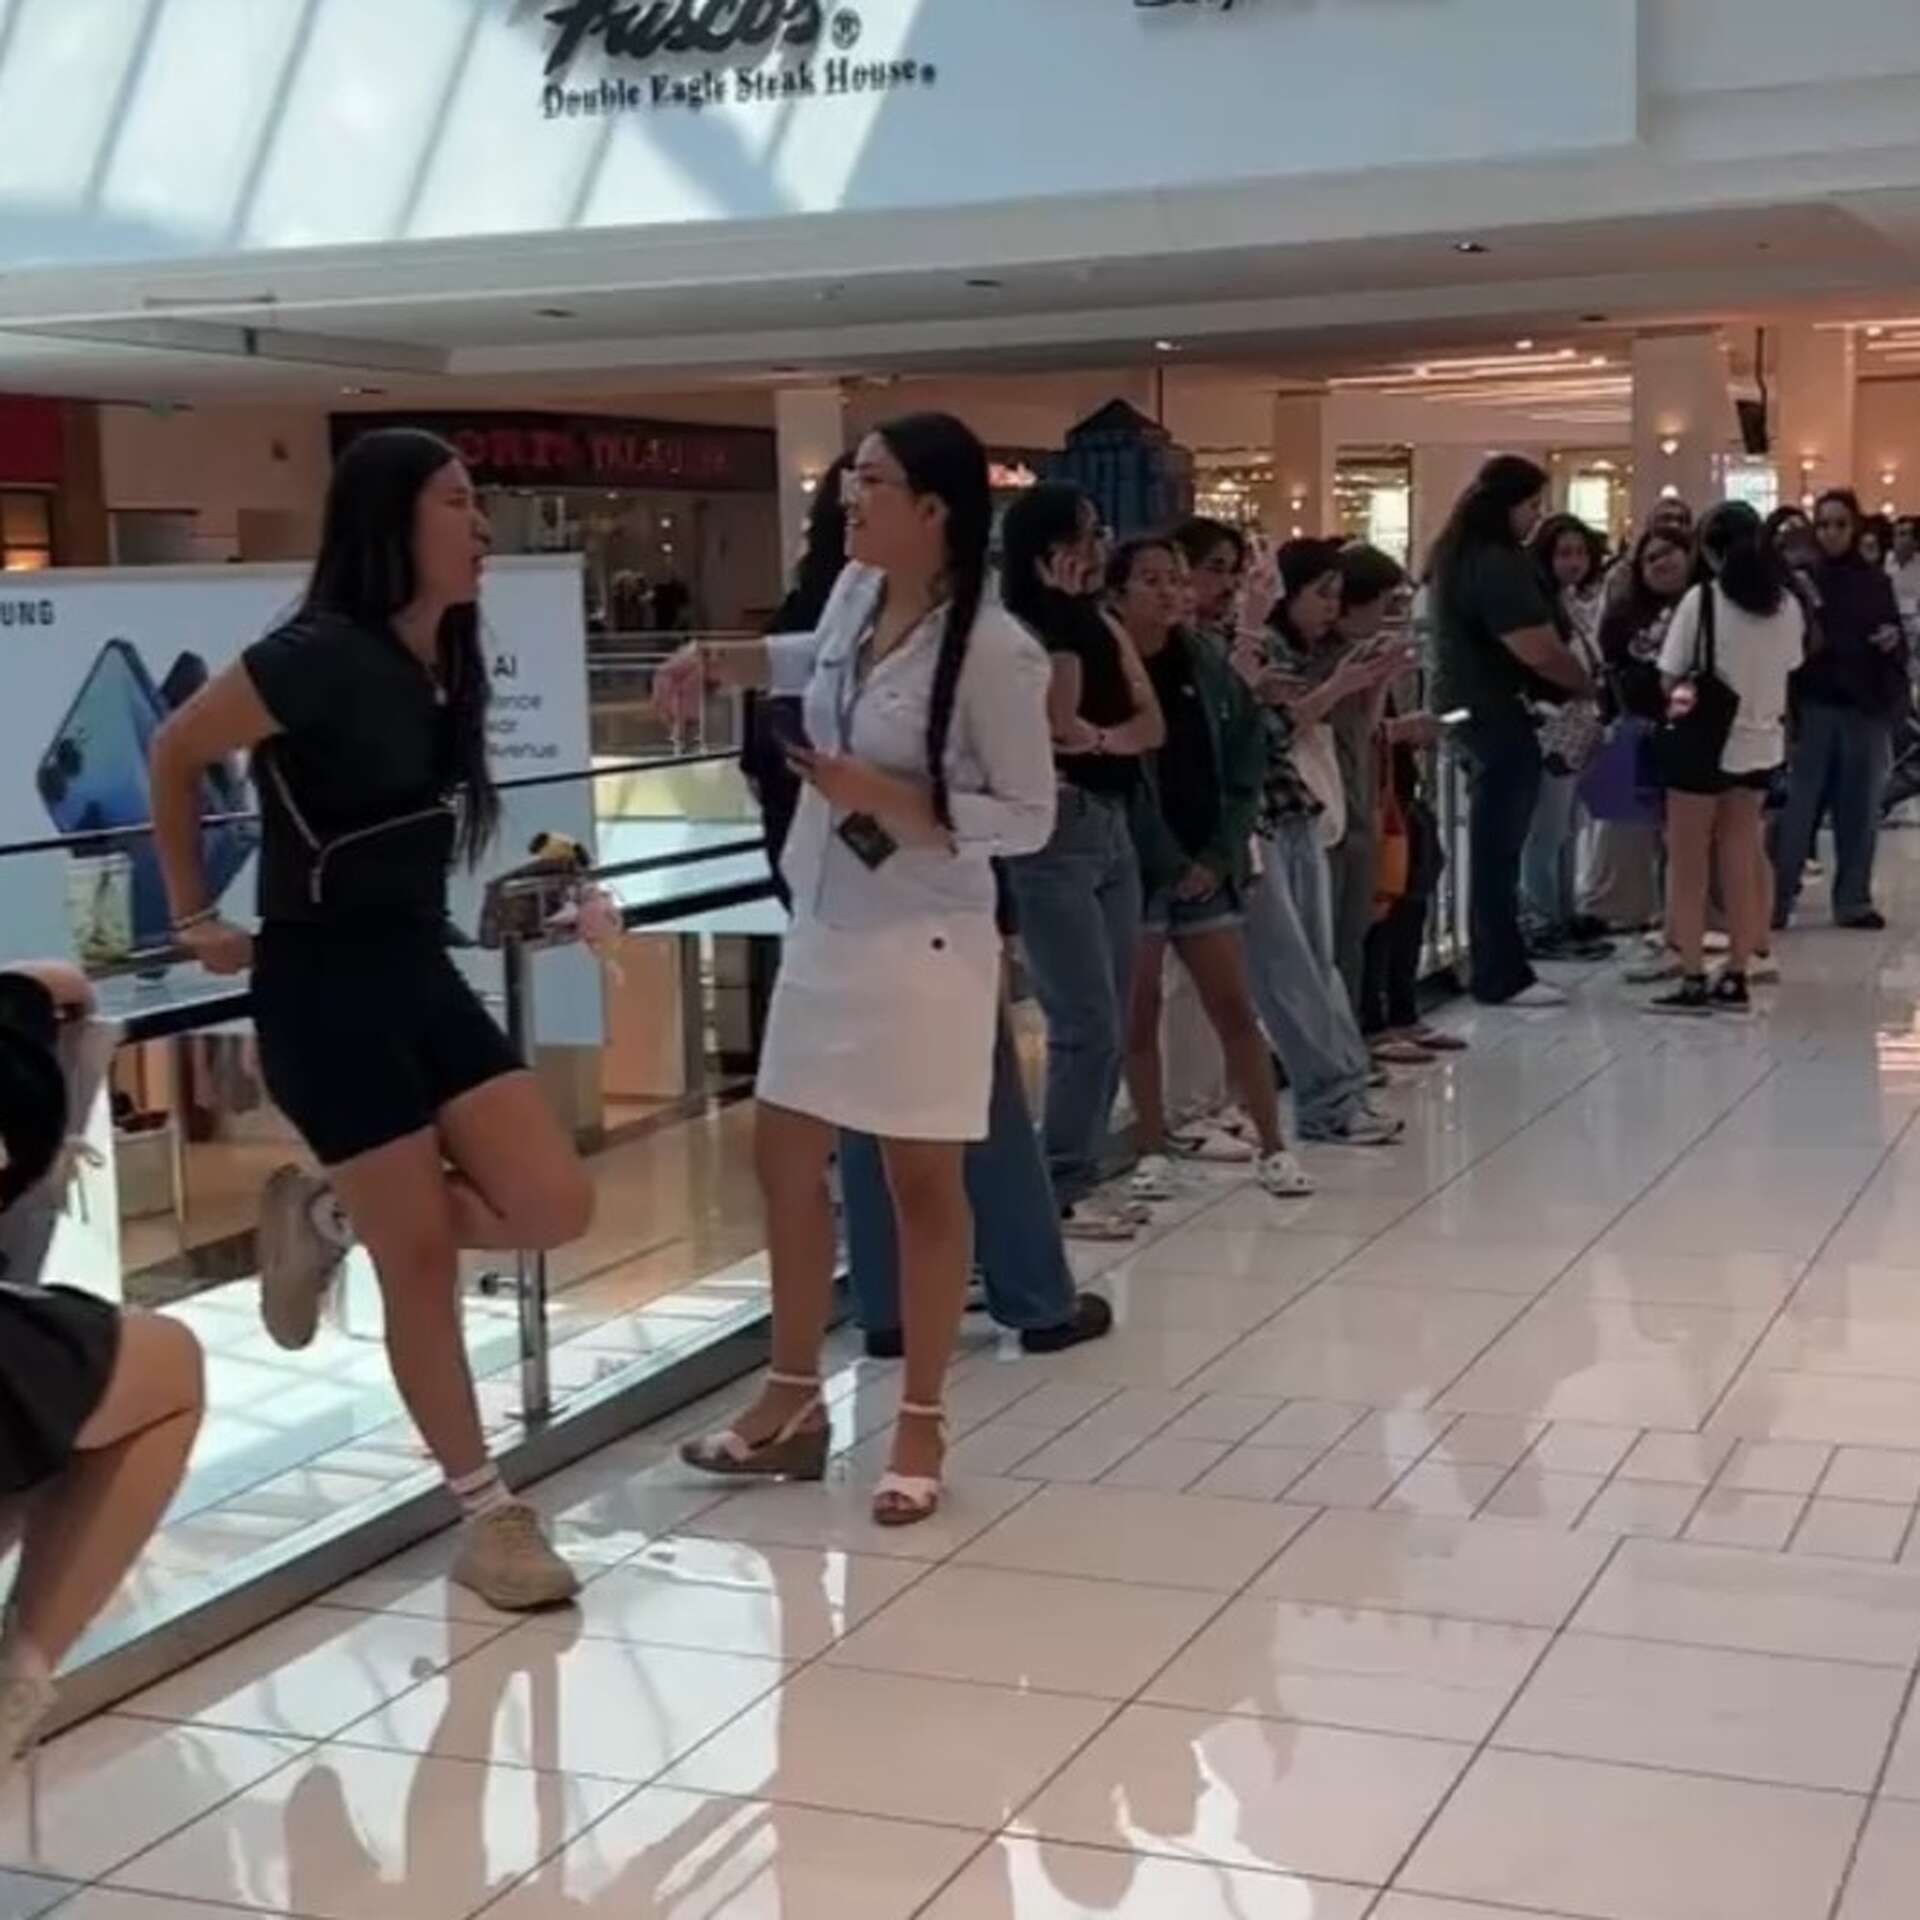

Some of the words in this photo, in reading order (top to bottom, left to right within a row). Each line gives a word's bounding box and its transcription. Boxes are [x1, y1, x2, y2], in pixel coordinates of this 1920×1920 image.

[543, 78, 640, 119] Double
[651, 70, 726, 109] Eagle
[737, 62, 816, 103] Steak
[493, 655, 517, 678] AI
